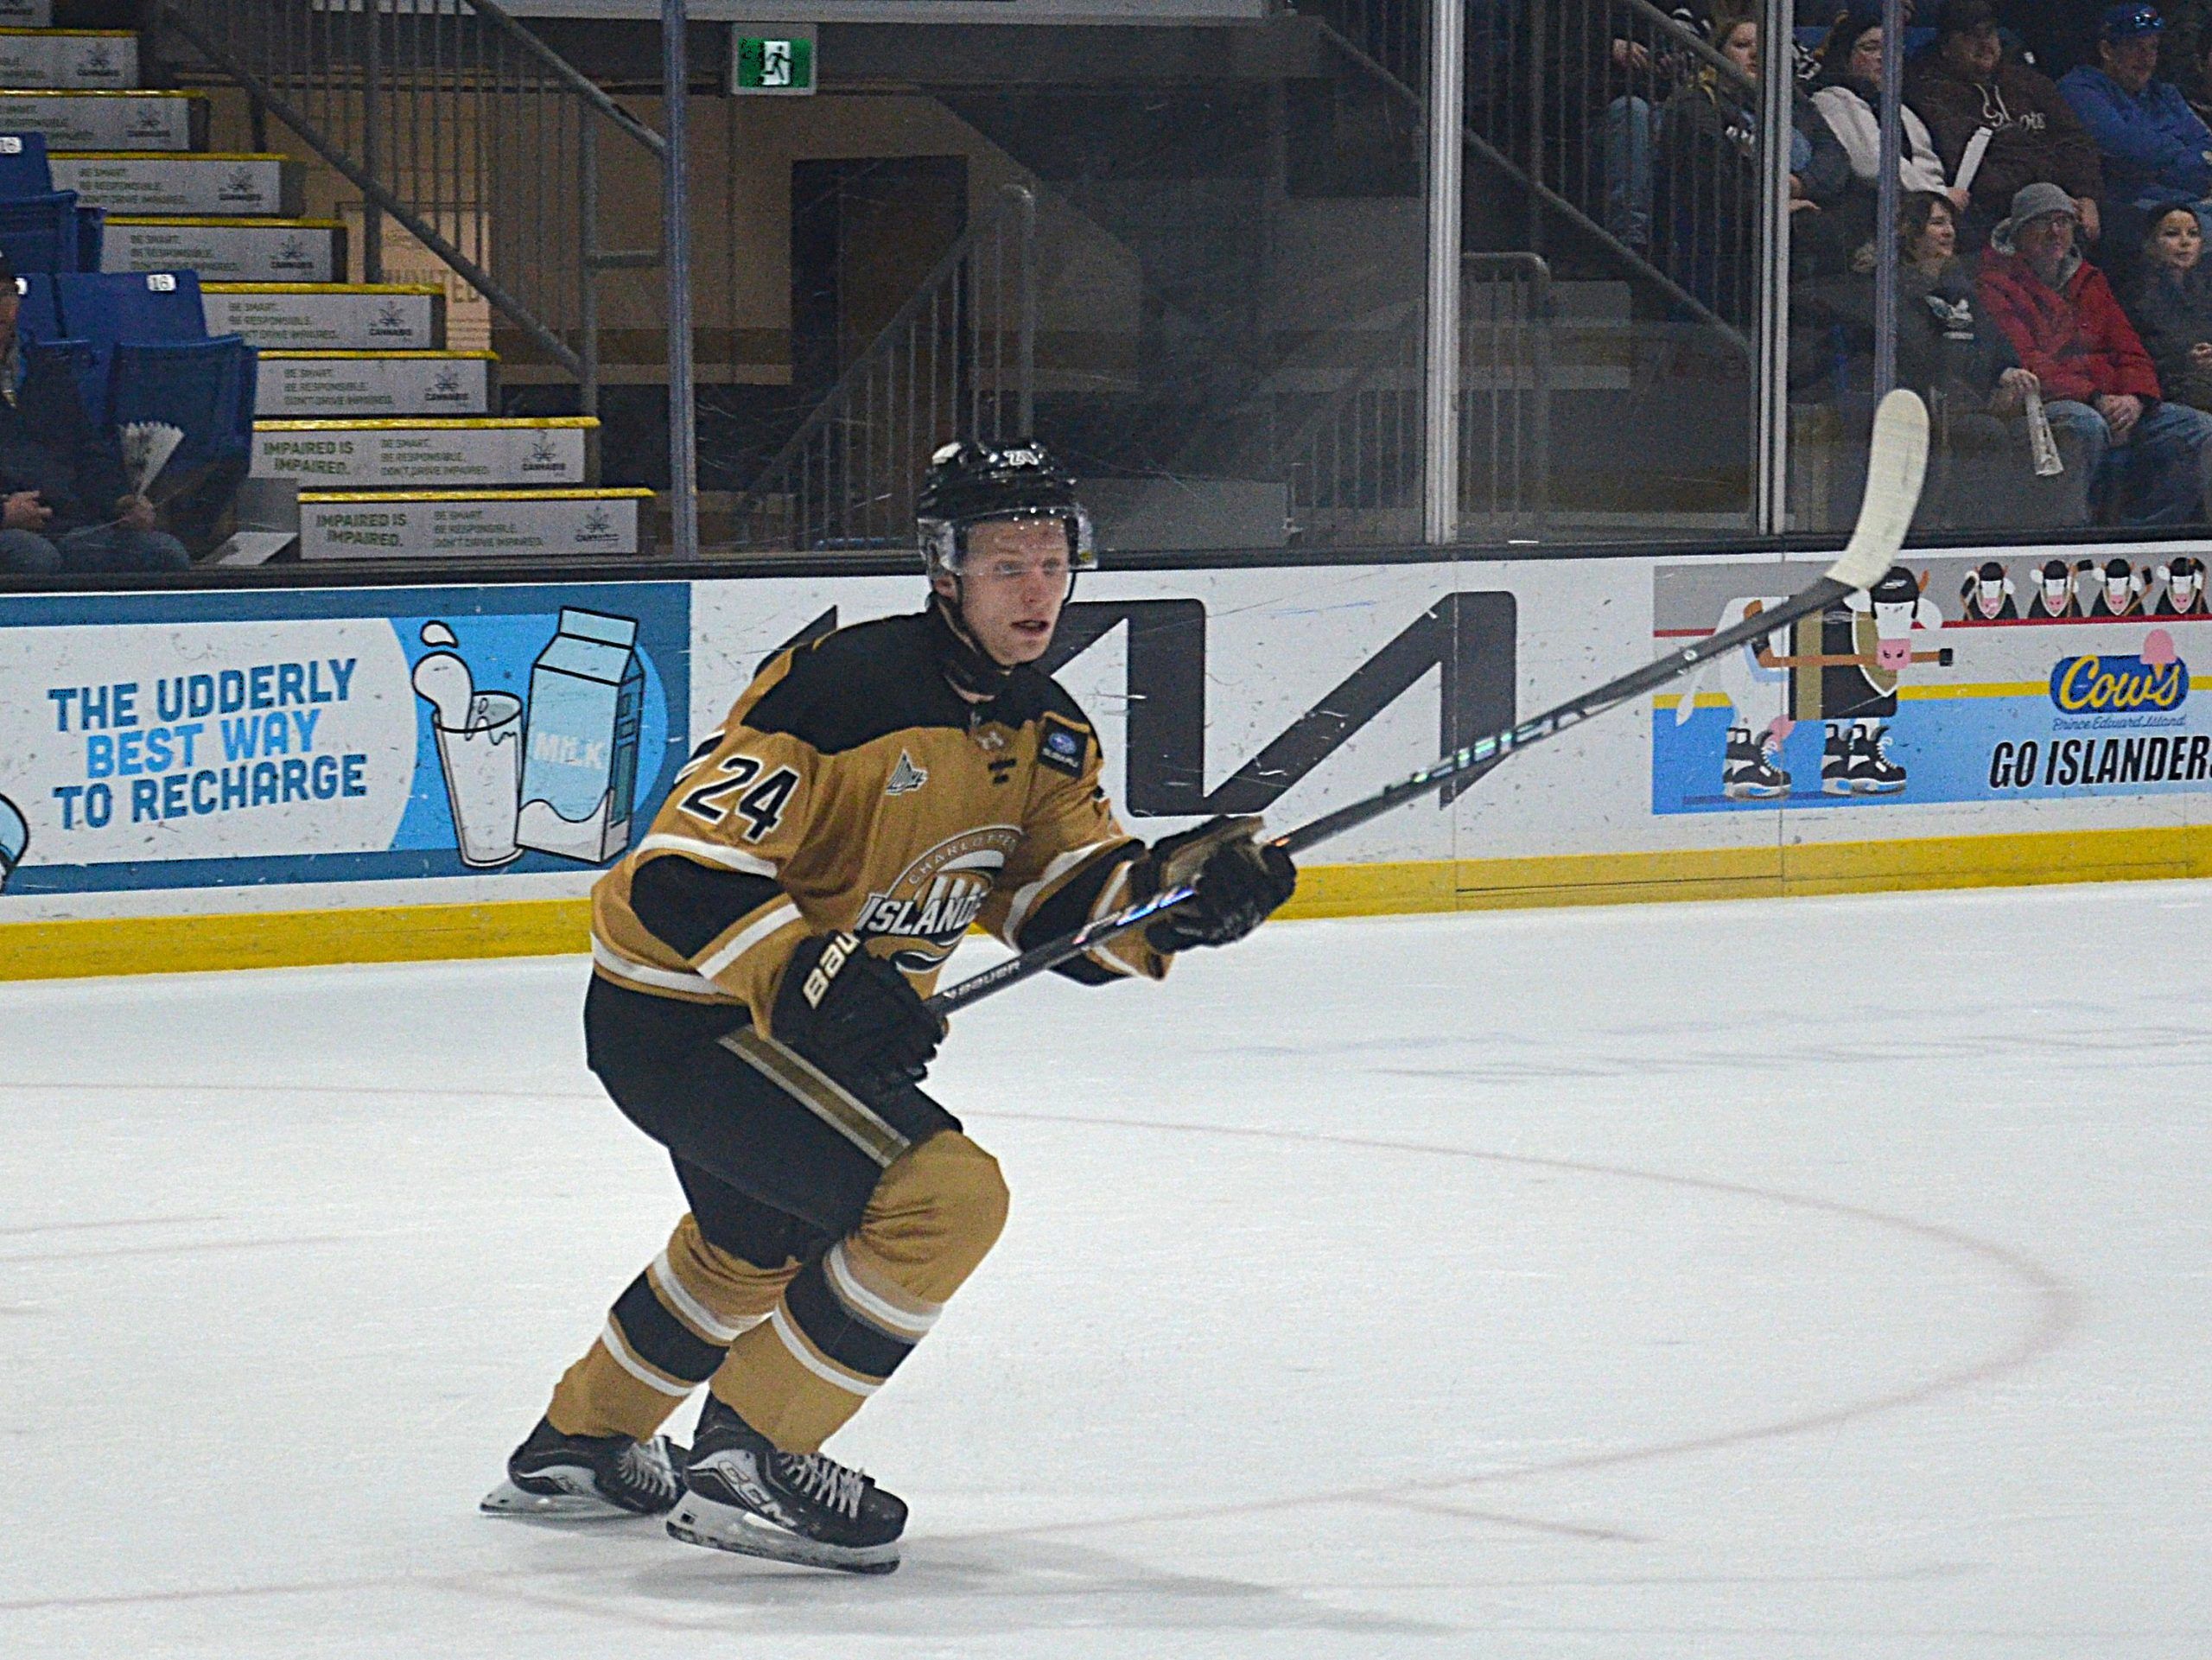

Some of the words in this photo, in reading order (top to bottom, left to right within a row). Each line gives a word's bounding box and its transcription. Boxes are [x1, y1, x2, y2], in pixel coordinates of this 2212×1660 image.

[264, 442, 337, 455] IMPAIRED
[339, 441, 354, 454] IS
[316, 514, 389, 527] IMPAIRED
[391, 513, 407, 526] IS
[327, 530, 404, 546] IMPAIRED.
[48, 682, 139, 732] THE
[156, 658, 359, 721] UDDERLY
[87, 723, 204, 779] BEST
[221, 709, 322, 762] WAY
[2052, 717, 2091, 732] Prince
[2091, 715, 2142, 730] Edward
[533, 732, 607, 769] MILK
[1989, 741, 2039, 789] GO
[2044, 735, 2212, 786] ISLANDER
[52, 784, 113, 830] TO
[131, 753, 368, 824] RECHARGE
[677, 754, 800, 845] 24
